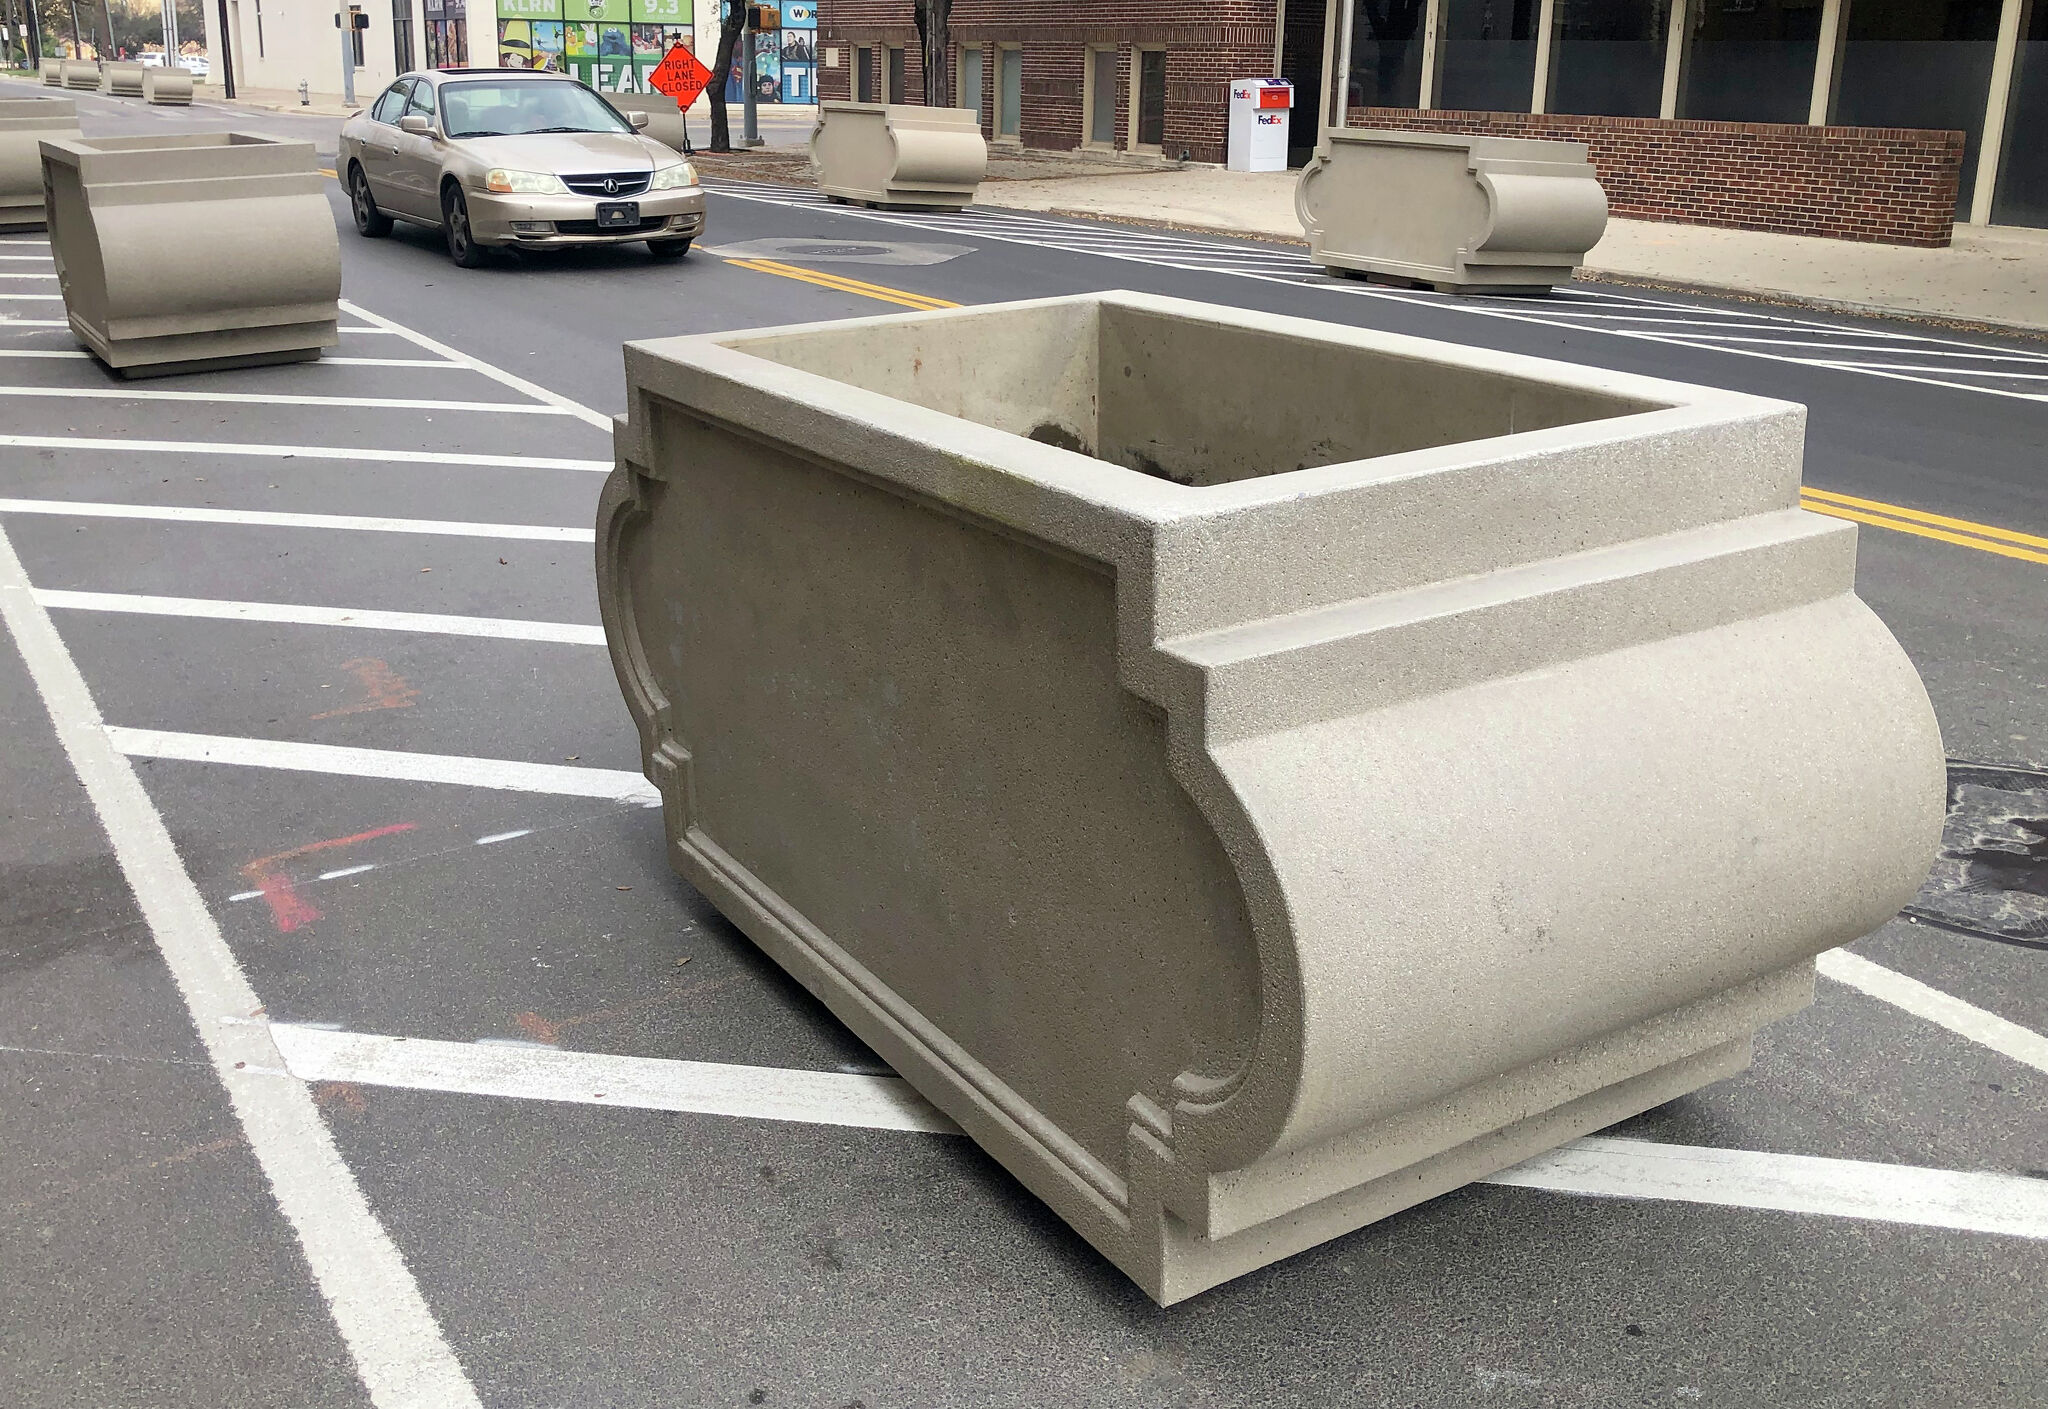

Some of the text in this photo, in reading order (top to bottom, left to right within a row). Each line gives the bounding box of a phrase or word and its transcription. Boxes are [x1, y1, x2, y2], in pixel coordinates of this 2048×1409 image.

[664, 58, 695, 70] RIGHT
[667, 70, 695, 81] LANE
[661, 80, 703, 93] CLOSED
[1233, 89, 1251, 99] FedEx
[1258, 115, 1282, 125] FedEx
